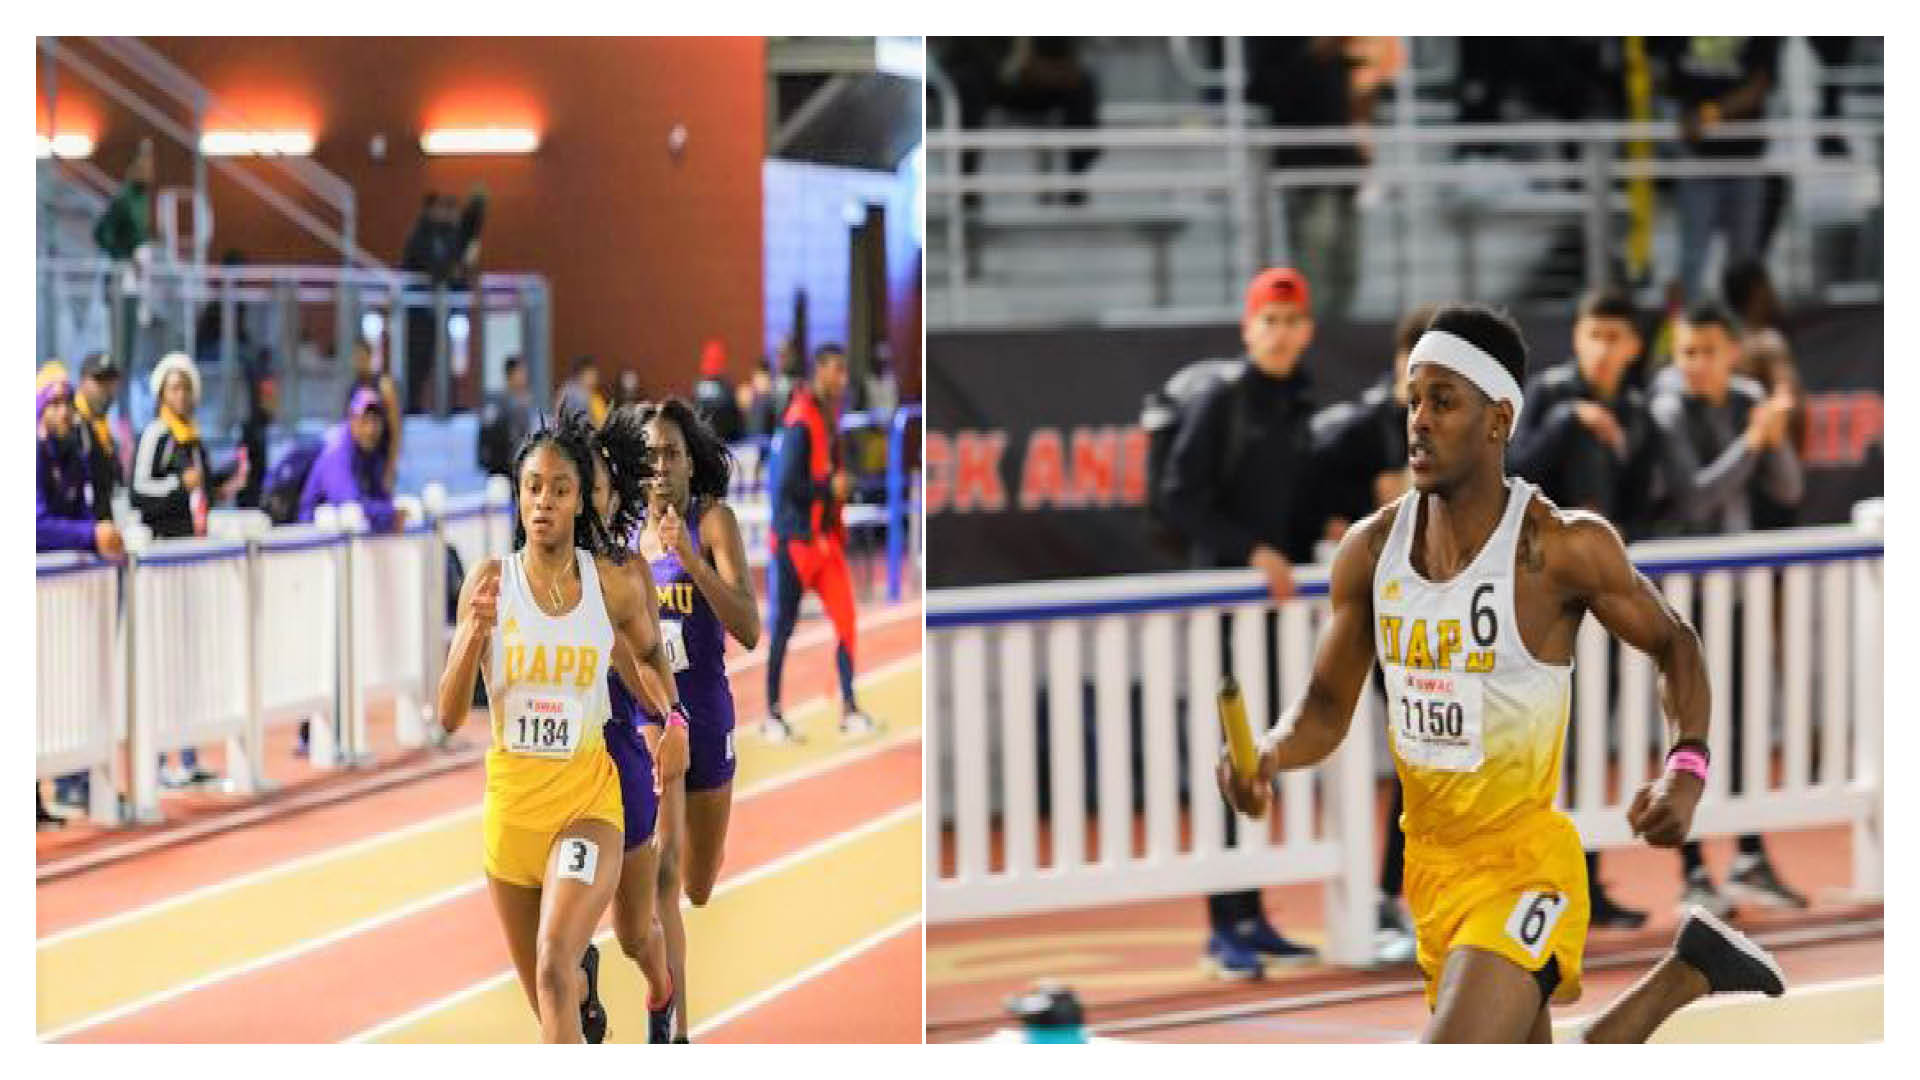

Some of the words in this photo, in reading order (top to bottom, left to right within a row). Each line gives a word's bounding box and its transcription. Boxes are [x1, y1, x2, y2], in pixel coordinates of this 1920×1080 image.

[1470, 582, 1498, 647] 6
[505, 642, 599, 687] UAPB
[518, 716, 568, 746] 1134
[1401, 696, 1463, 736] 1150
[569, 842, 587, 871] 3
[1520, 892, 1560, 945] 6
